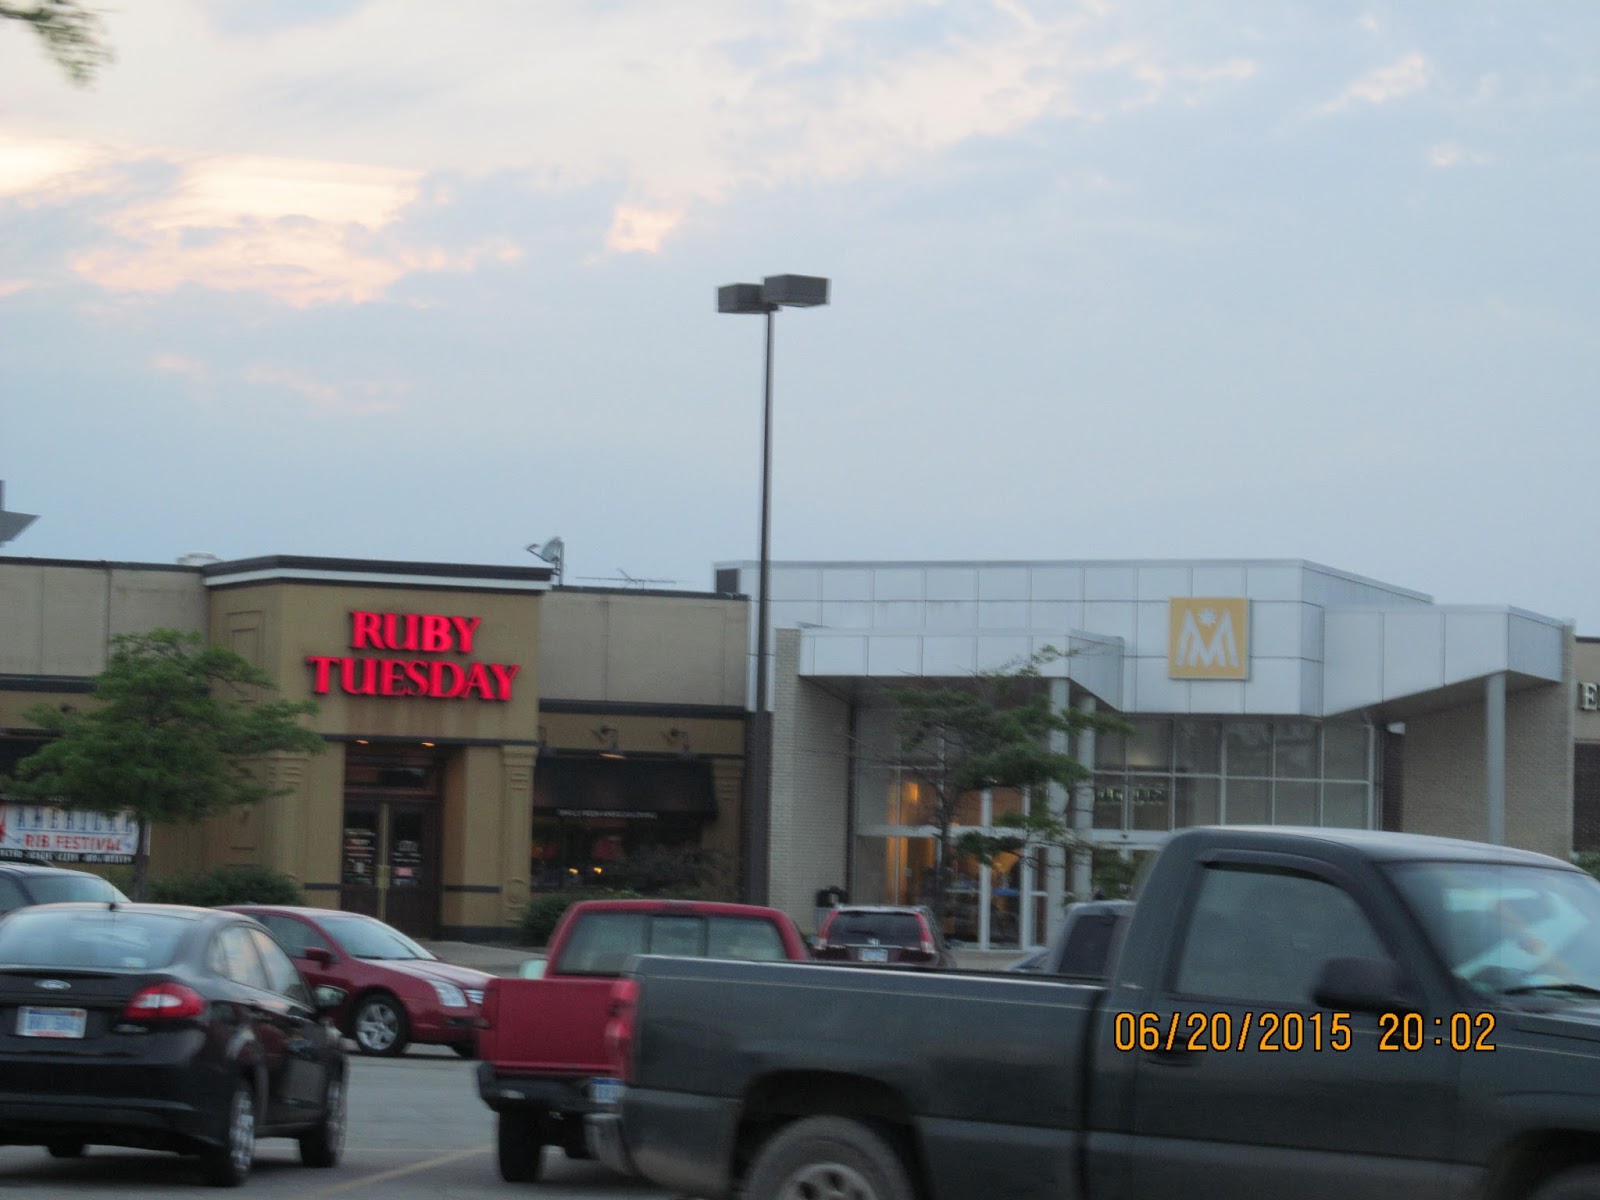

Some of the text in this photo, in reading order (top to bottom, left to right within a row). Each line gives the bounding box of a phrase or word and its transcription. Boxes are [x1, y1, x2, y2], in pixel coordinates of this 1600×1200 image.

[349, 611, 482, 653] RUBY
[306, 655, 521, 701] TUESDAY
[25, 833, 122, 851] RIB FESTIVAL
